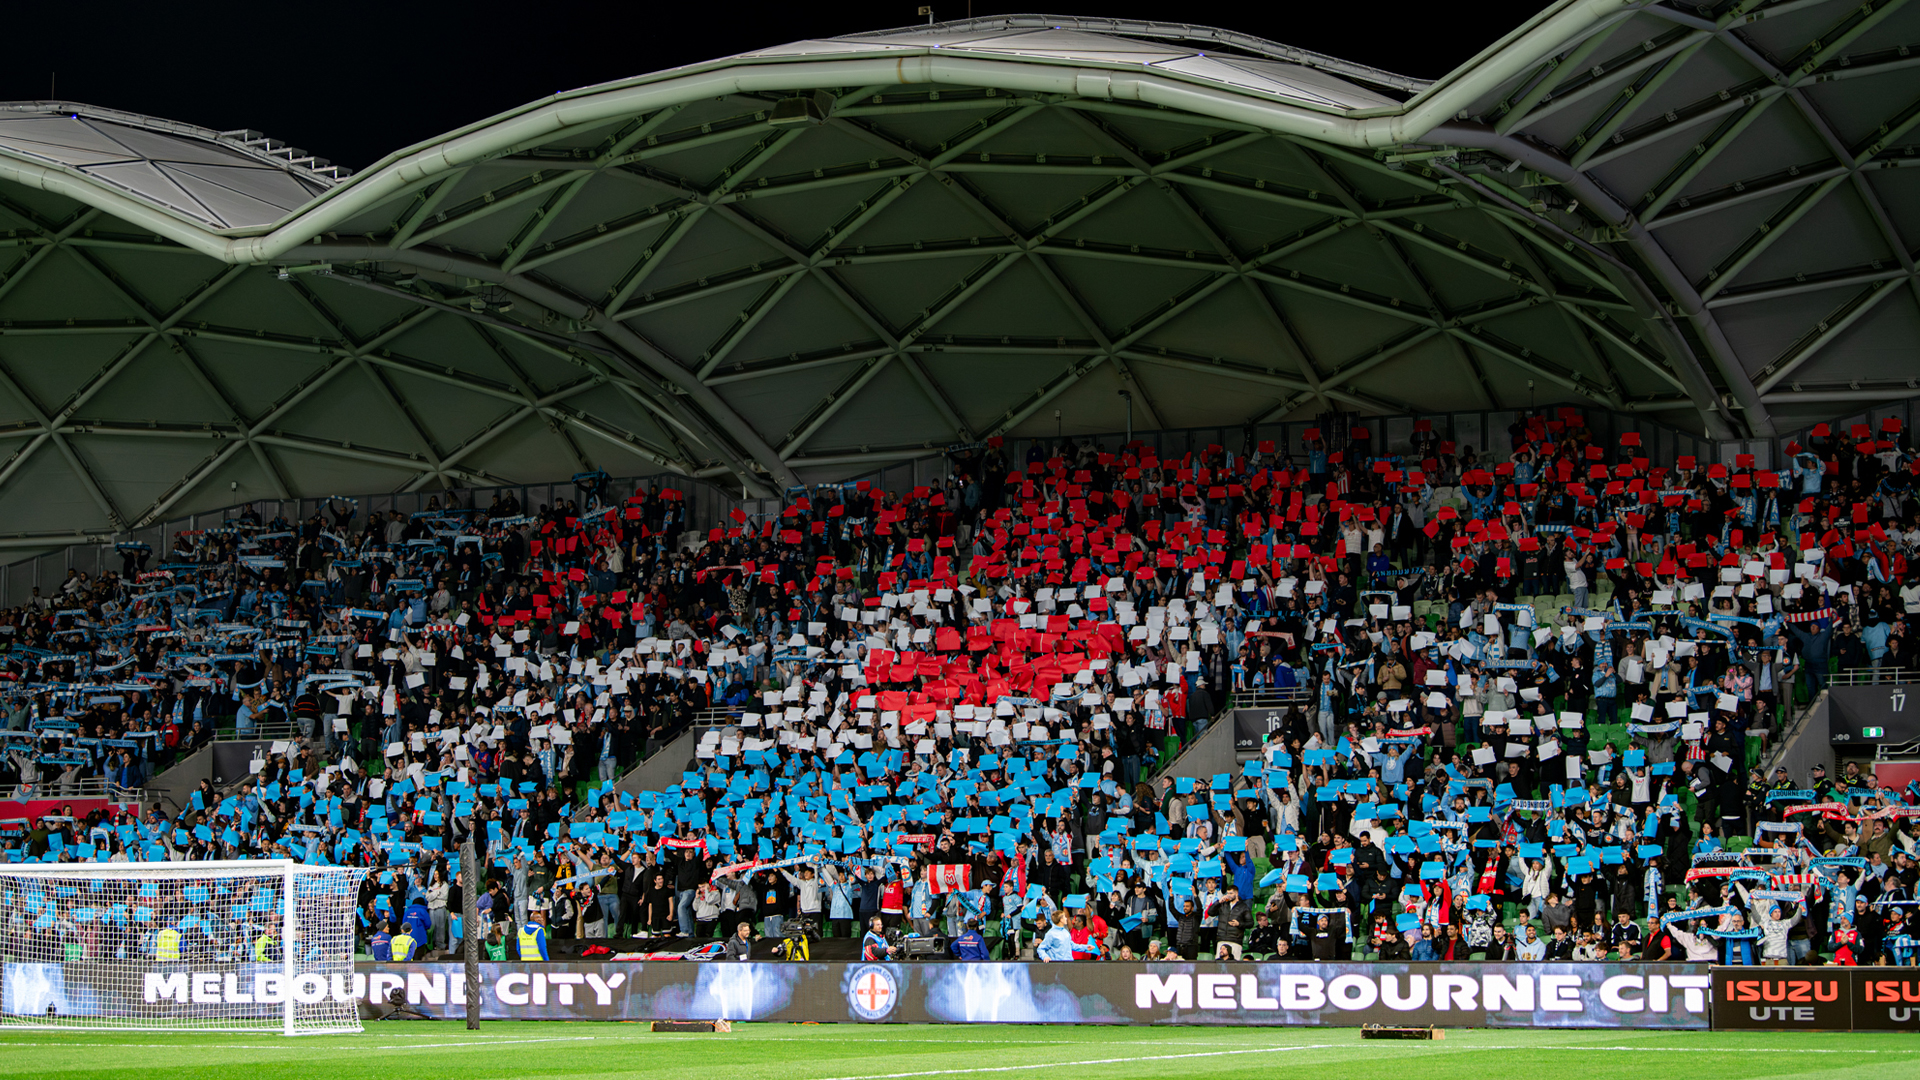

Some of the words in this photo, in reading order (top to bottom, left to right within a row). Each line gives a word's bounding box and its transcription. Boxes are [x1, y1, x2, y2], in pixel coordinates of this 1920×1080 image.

[1601, 611, 1613, 620] CITY
[1488, 659, 1499, 667] THIS
[1499, 659, 1505, 667] IS
[1890, 693, 1906, 712] 17
[1266, 716, 1281, 733] 16
[1883, 790, 1898, 798] CITY
[1792, 802, 1839, 810] MELBOURNE
[1756, 890, 1800, 898] CHAMPIONS
[1675, 910, 1694, 918] HAPPY
[1694, 906, 1727, 914] TOGETHER
[144, 972, 482, 1005] MELBOURNE
[495, 972, 626, 1005] CITY
[1135, 973, 1583, 1011] MELBOURNE
[1600, 975, 1708, 1012] CIT
[1726, 980, 1838, 1002] ISUZU
[1749, 1006, 1815, 1021] UTE
